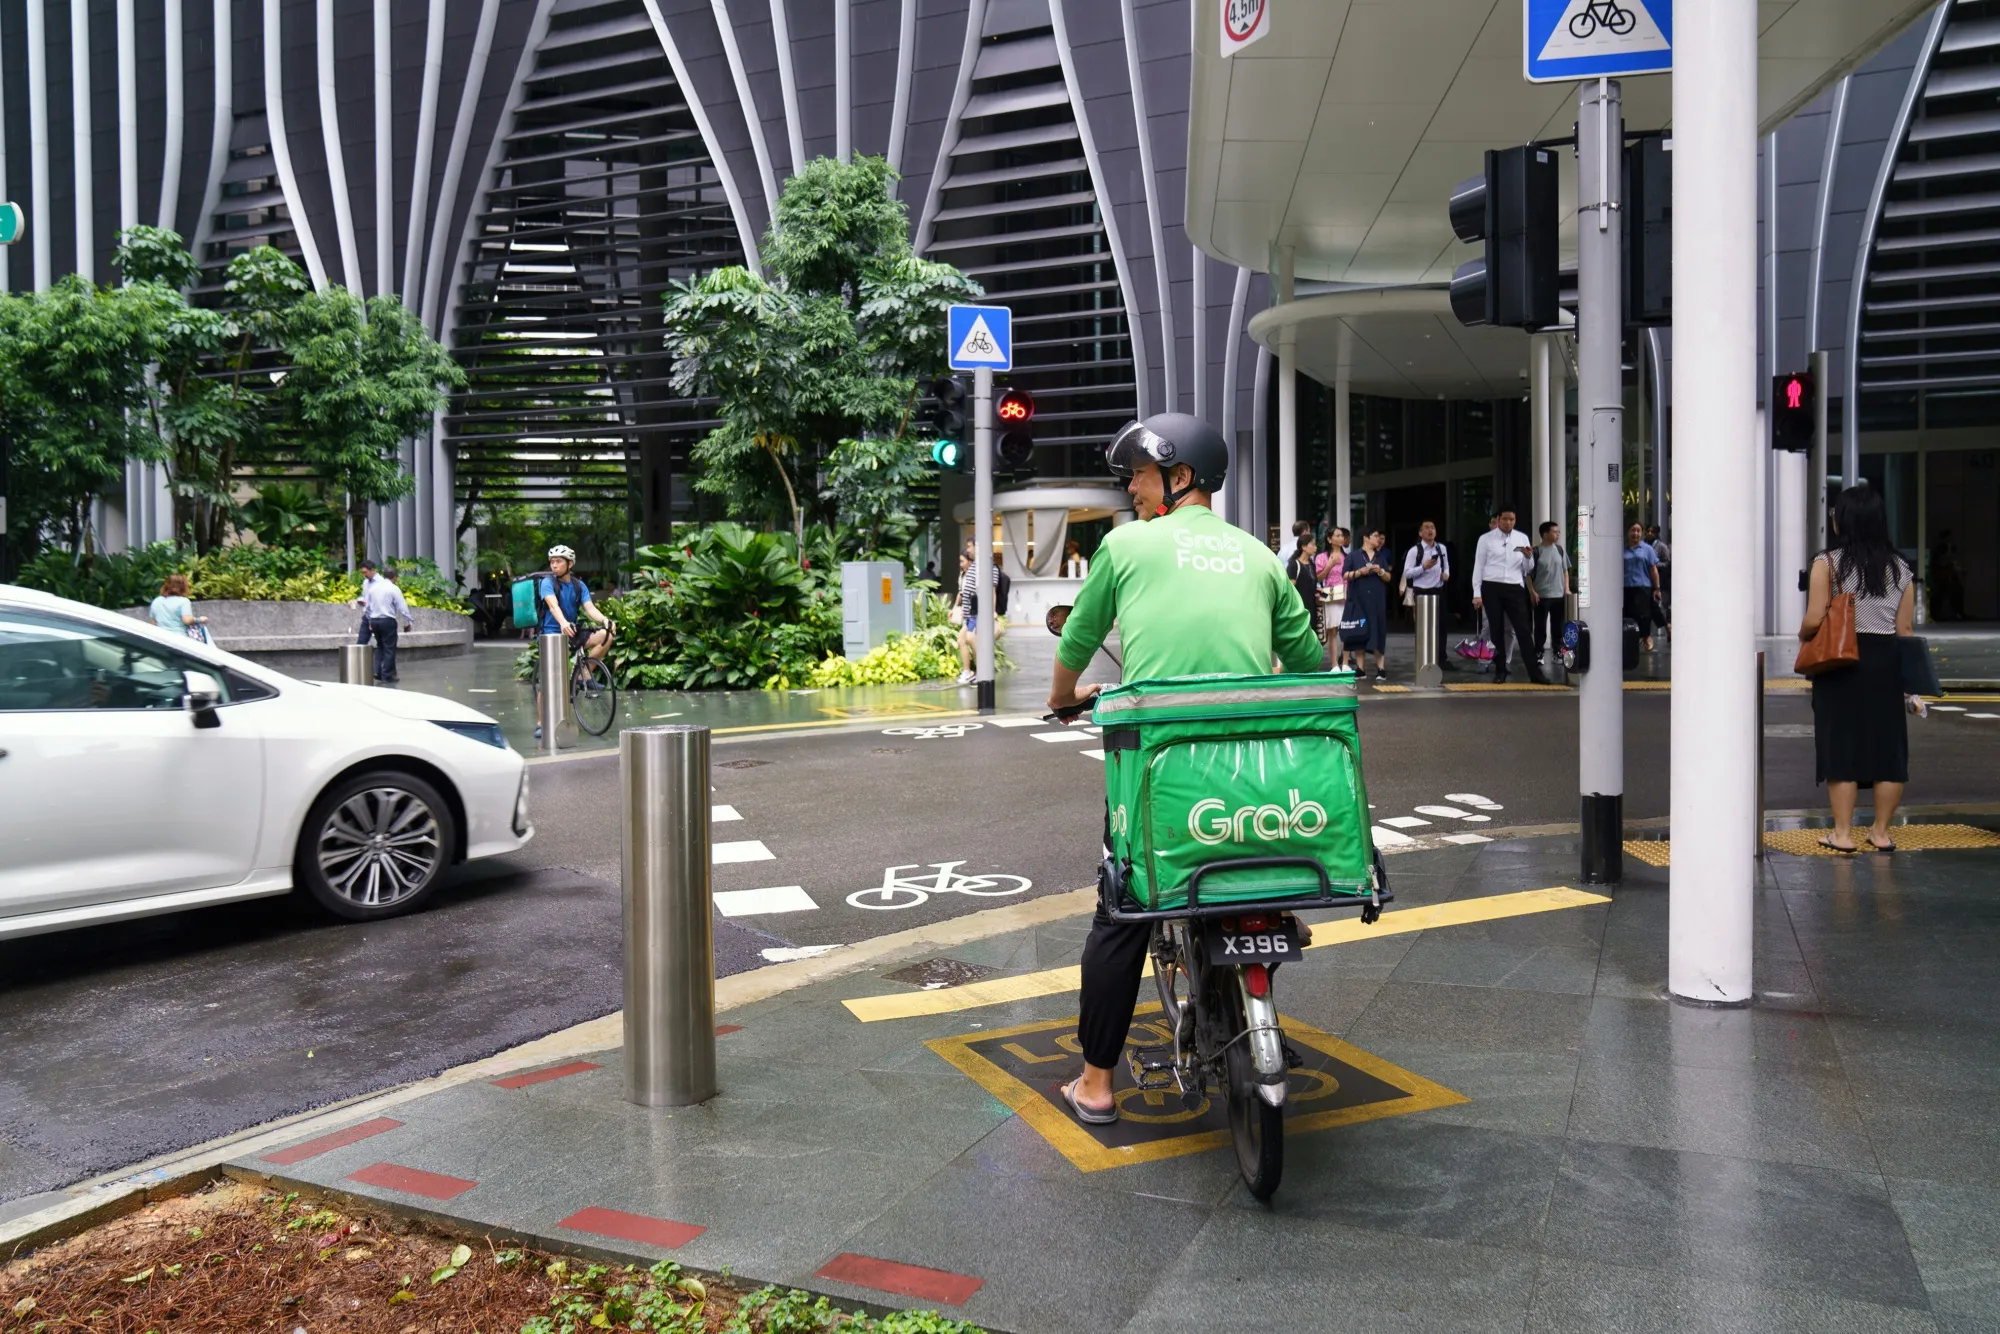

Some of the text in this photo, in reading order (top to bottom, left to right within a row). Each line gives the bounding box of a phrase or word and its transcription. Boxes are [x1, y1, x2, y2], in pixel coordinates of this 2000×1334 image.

[1230, 0, 1259, 24] 4.5m
[1173, 528, 1243, 552] Grab
[1176, 548, 1245, 575] Food
[1188, 788, 1328, 846] Grab
[1222, 934, 1289, 956] X396
